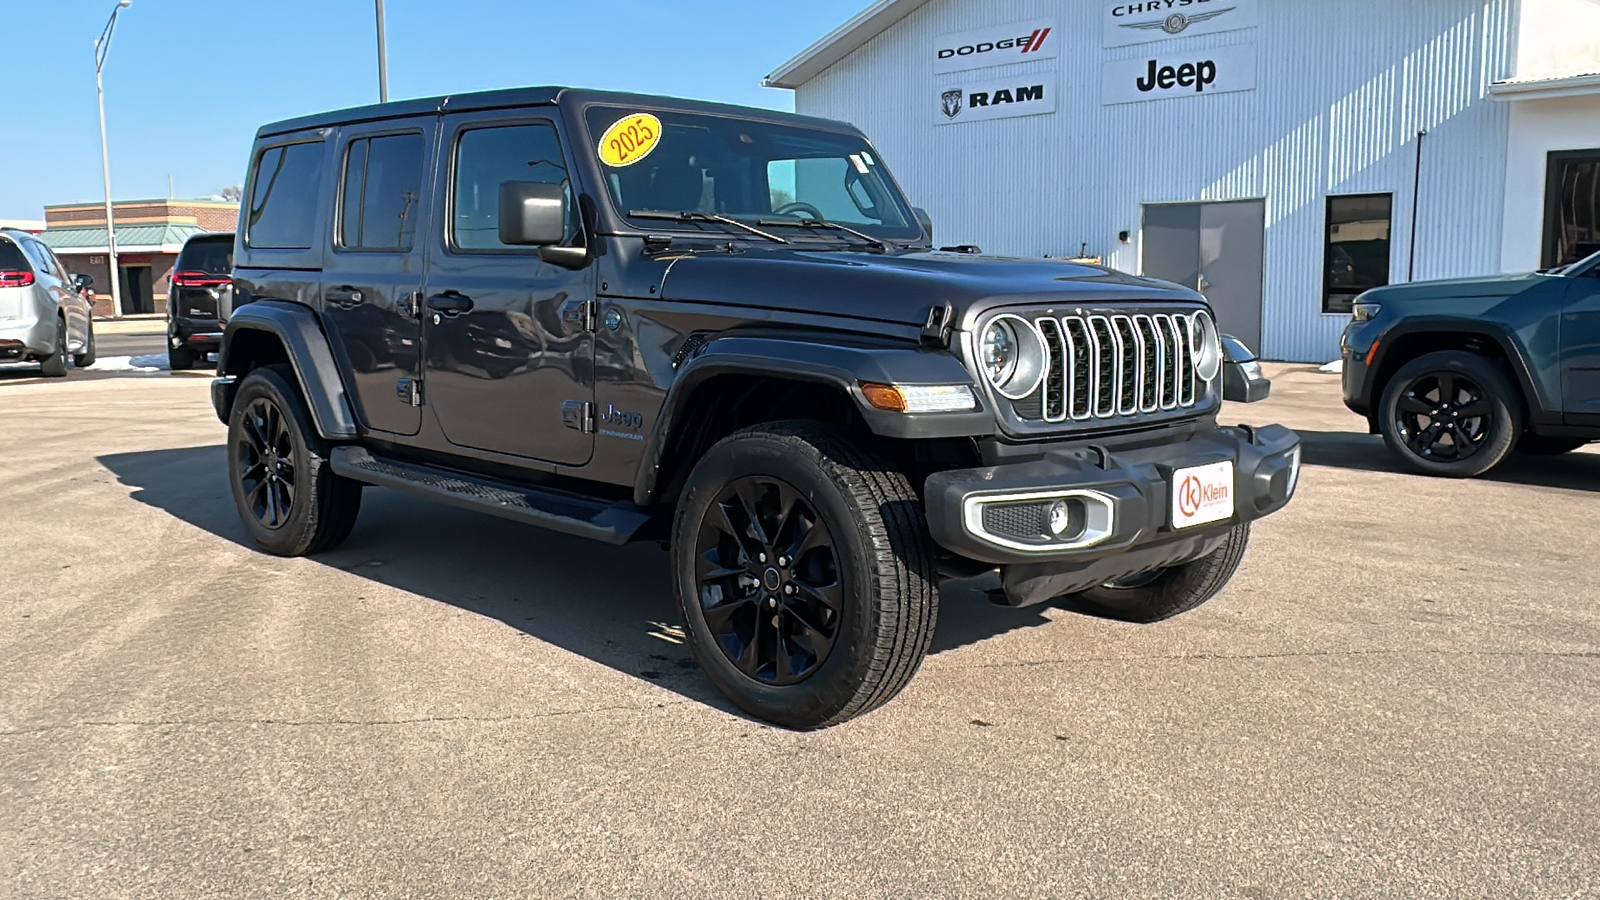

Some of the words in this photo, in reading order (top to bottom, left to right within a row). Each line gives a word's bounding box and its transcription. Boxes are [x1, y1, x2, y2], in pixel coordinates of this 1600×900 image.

[1112, 0, 1209, 17] CHRYS
[938, 36, 1033, 59] DODGE
[1136, 59, 1216, 92] Jeep
[970, 85, 1043, 108] RAM
[610, 119, 653, 161] 2025
[600, 404, 643, 431] Jeep
[1203, 483, 1228, 501] Klein
